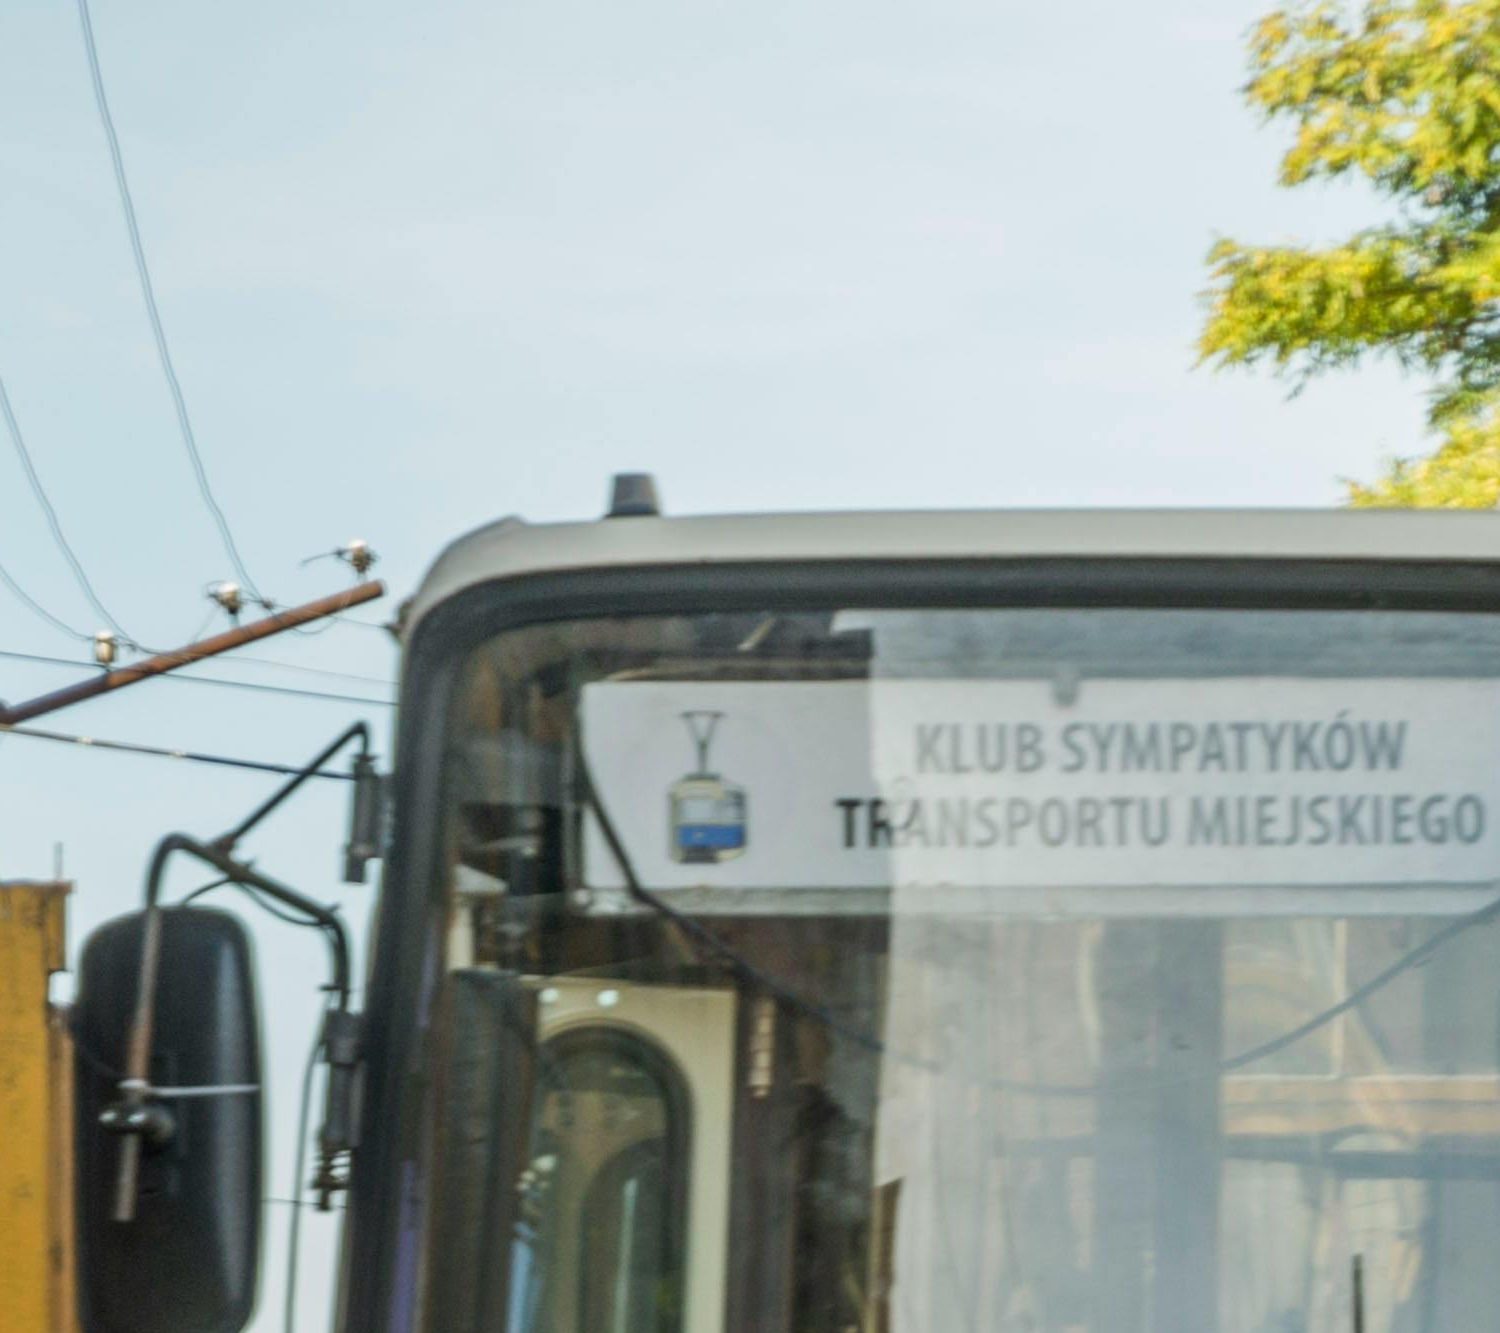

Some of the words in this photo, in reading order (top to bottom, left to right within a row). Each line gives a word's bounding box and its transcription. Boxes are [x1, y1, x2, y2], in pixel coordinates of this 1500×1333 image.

[914, 723, 1045, 774] KLUB
[1063, 710, 1408, 774] SYMPATYKÓW
[837, 797, 1169, 851] TRANSPORTU
[1187, 796, 1486, 848] MIEJSKIEGO
